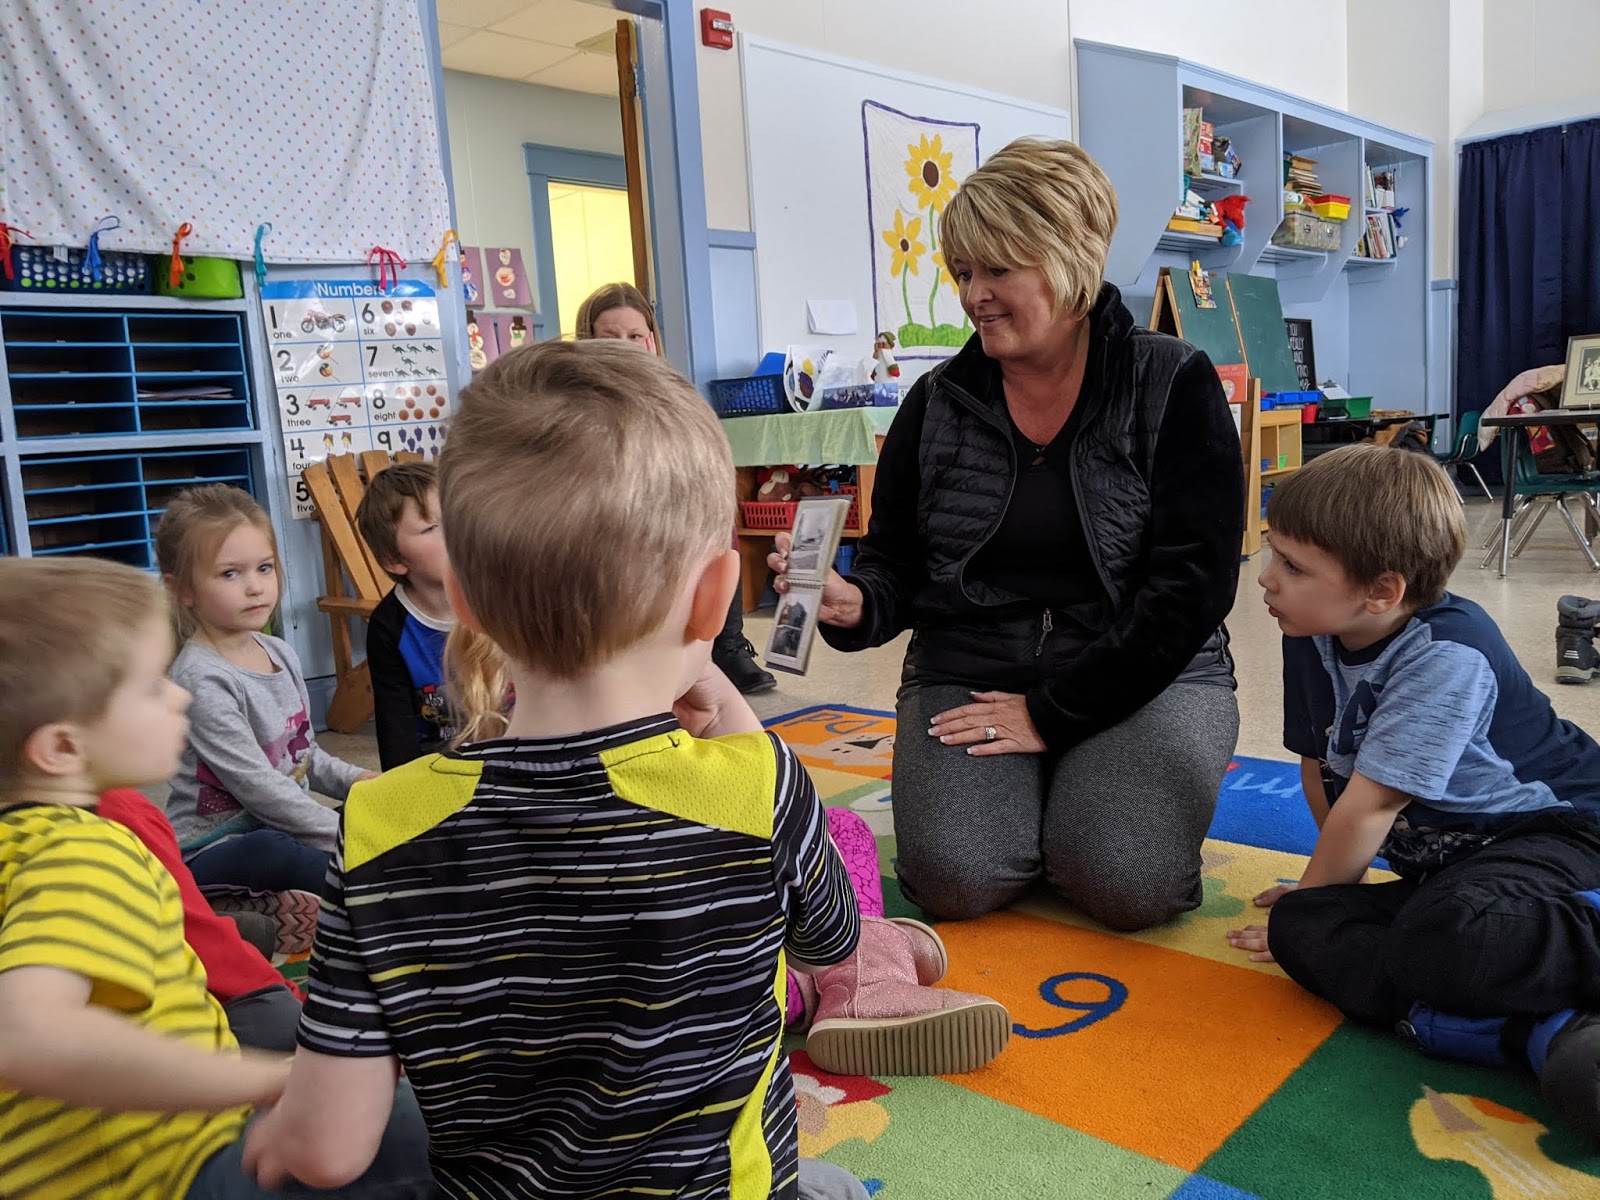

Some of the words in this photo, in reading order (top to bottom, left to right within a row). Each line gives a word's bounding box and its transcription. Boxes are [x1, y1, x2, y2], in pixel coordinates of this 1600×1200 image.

[317, 282, 386, 297] Numbers
[269, 305, 278, 329] 1
[361, 303, 375, 324] 6
[273, 331, 292, 339] one
[277, 349, 294, 372] 2
[366, 346, 378, 367] 7
[280, 375, 300, 383] two
[368, 370, 394, 378] seven
[286, 394, 300, 416] 3
[373, 388, 386, 410] 8
[287, 418, 311, 427] three
[374, 411, 396, 422] eight
[290, 438, 305, 459] 4
[377, 431, 392, 451] 9
[292, 461, 311, 470] four
[295, 481, 310, 502] 5
[297, 504, 315, 513] five
